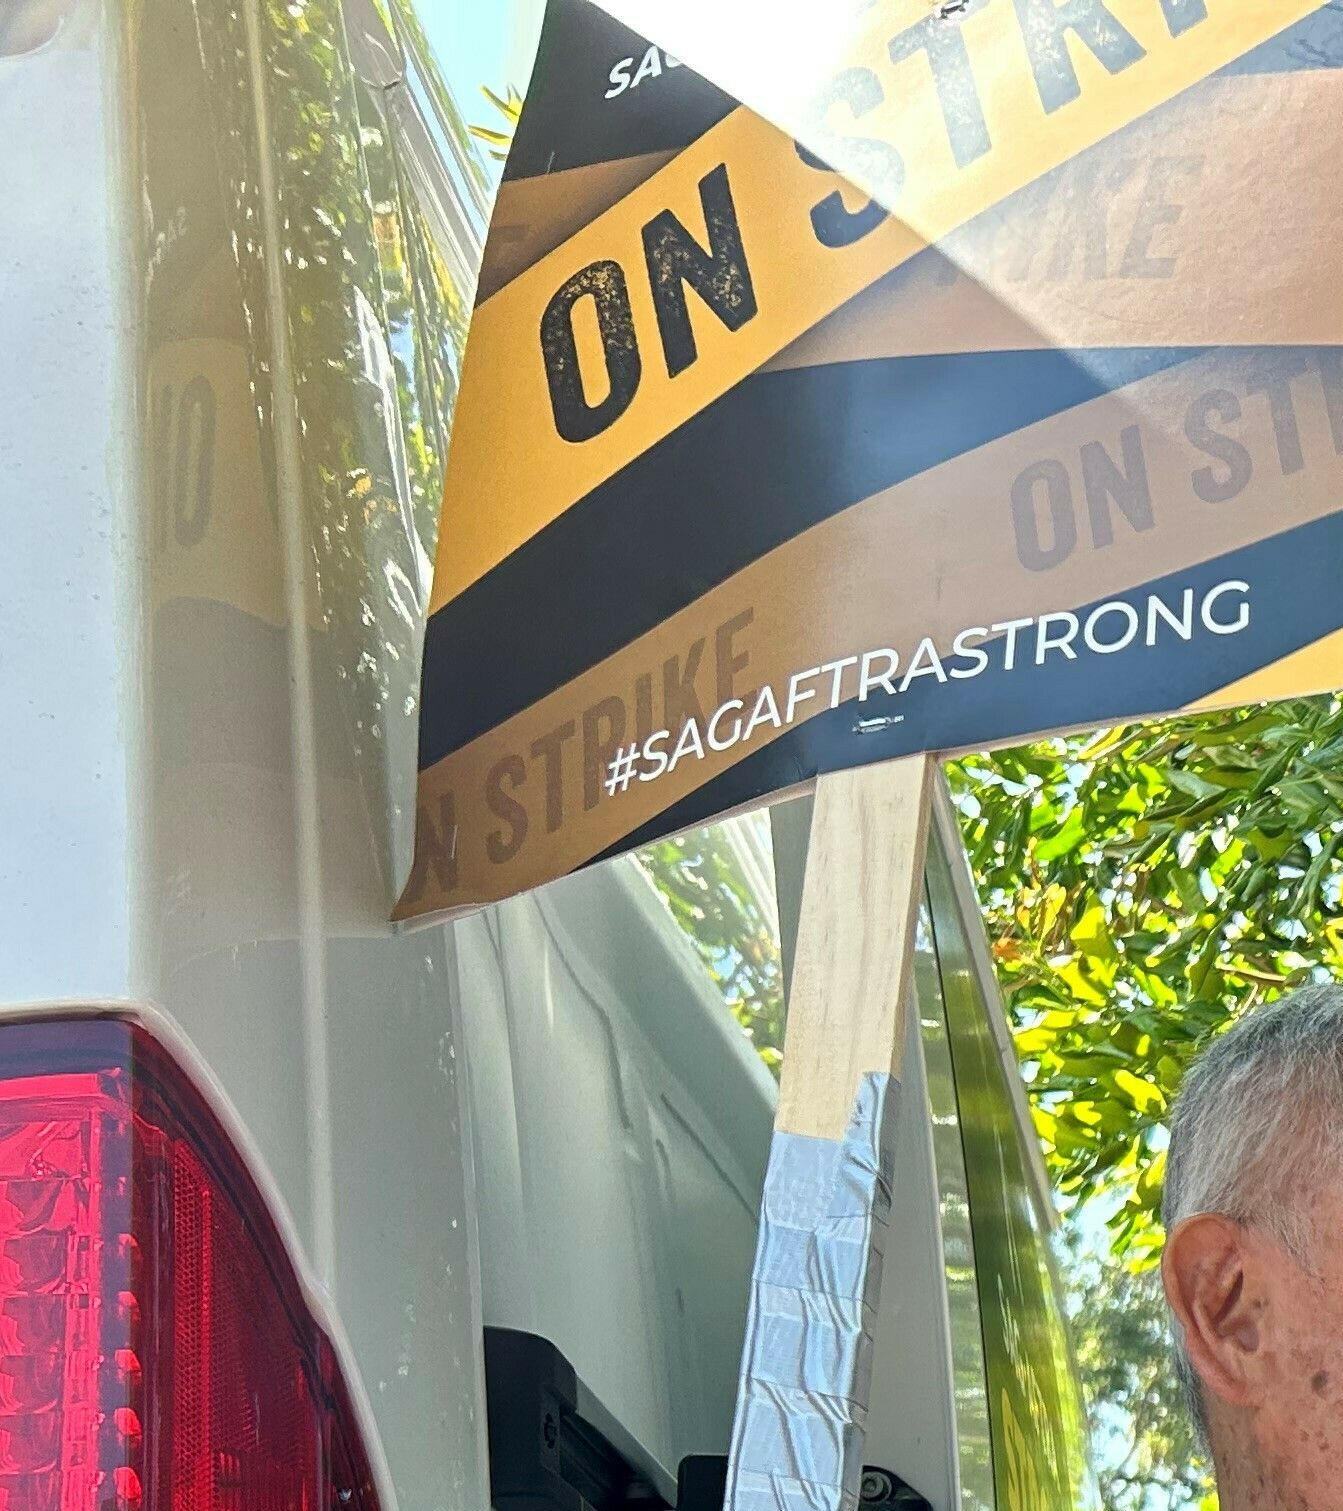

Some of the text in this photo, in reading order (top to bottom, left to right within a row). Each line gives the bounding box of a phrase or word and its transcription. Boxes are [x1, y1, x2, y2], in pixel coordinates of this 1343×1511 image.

[539, 0, 1208, 445] ON STR
[1009, 424, 1157, 573] ON
[485, 606, 755, 865] STRIKE
[604, 580, 1252, 797] #SAGAFTRASTRONG
